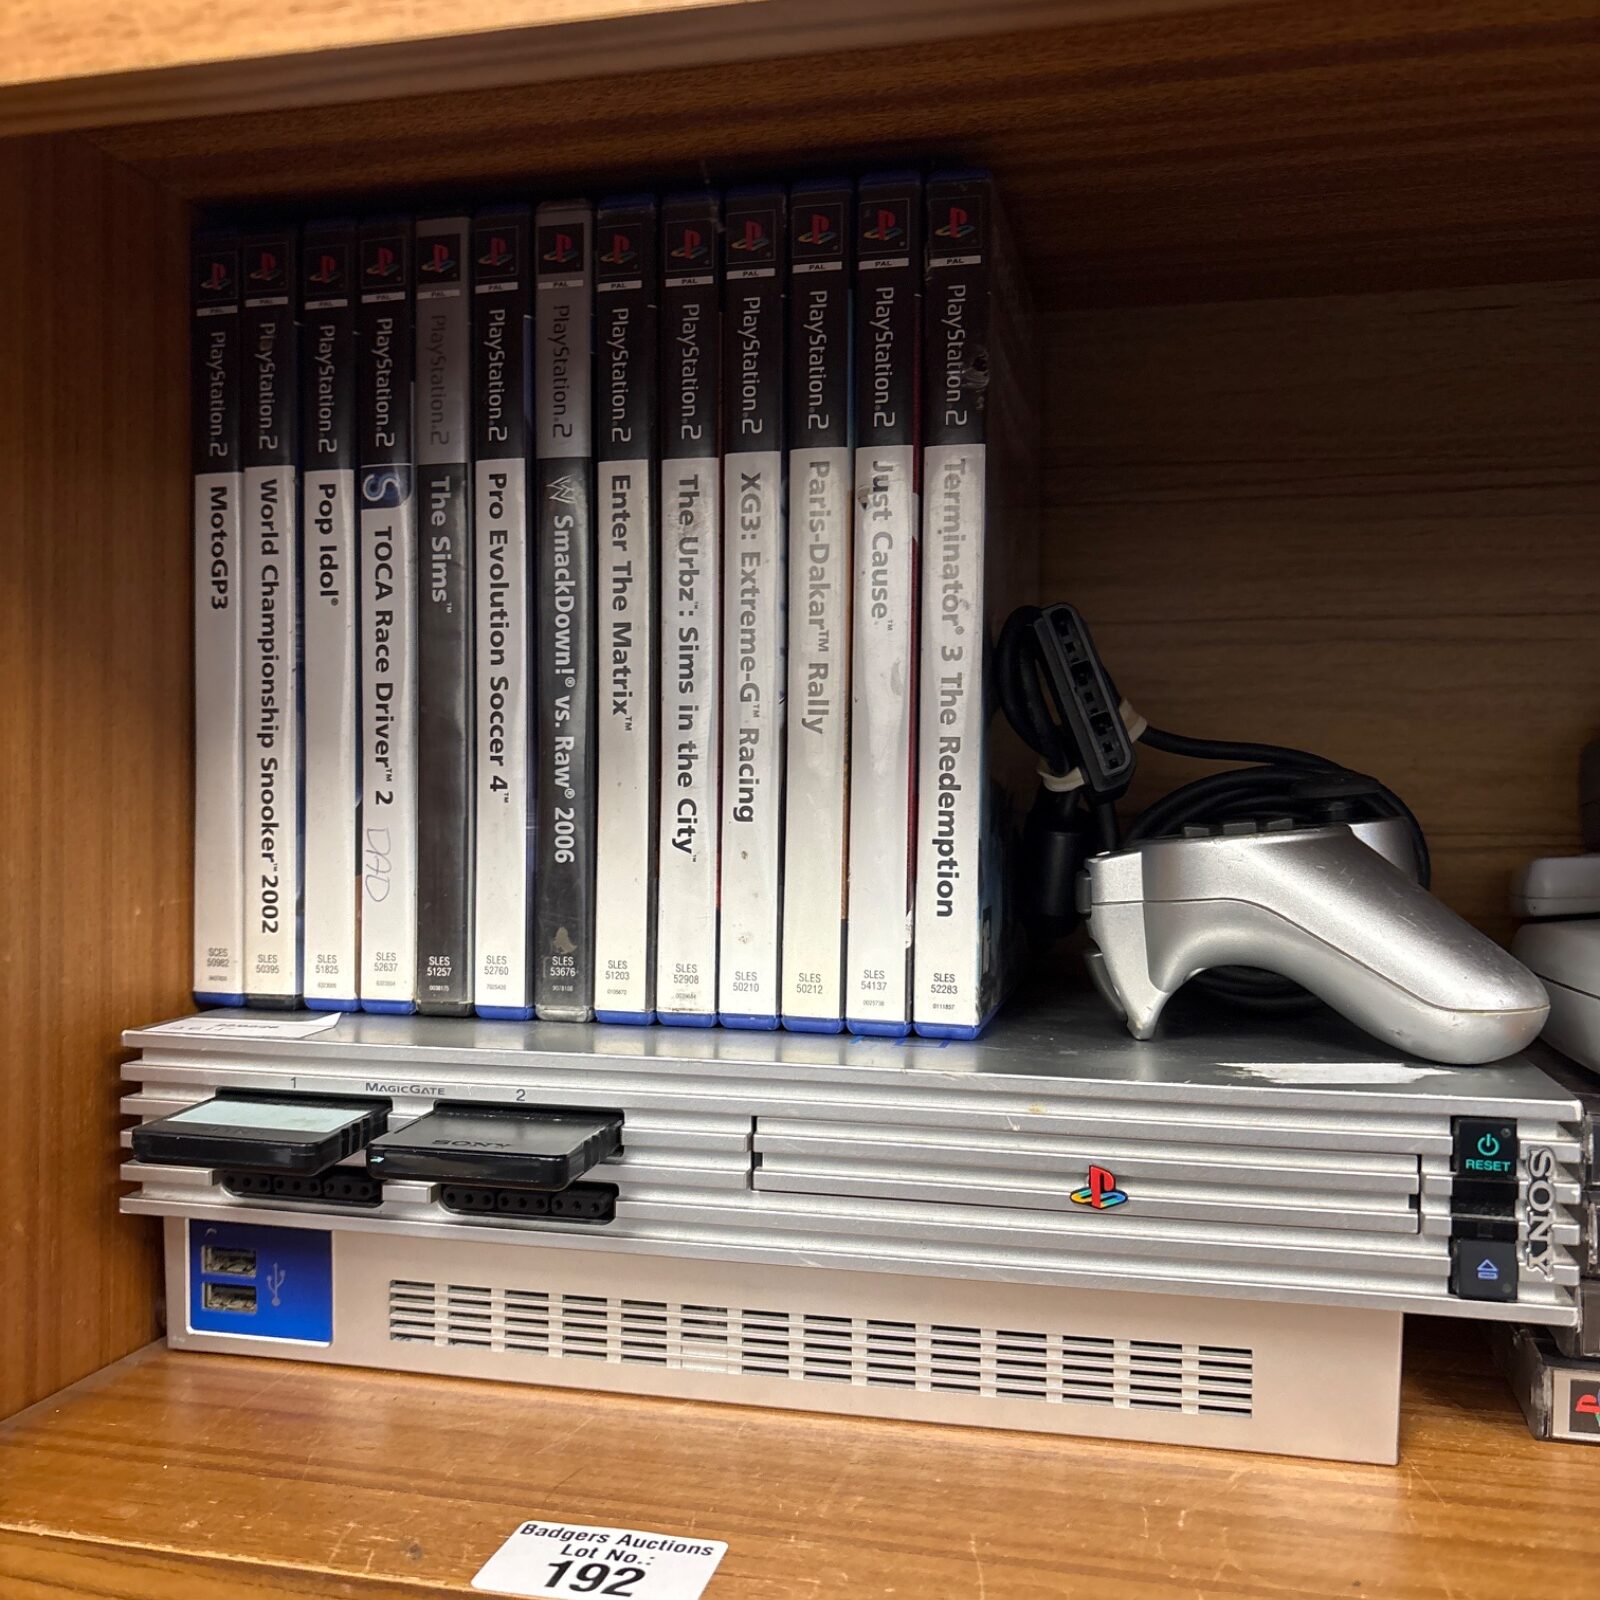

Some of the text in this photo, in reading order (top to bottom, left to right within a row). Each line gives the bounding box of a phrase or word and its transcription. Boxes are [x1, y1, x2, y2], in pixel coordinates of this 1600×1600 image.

[488, 473, 506, 520] Pro
[678, 474, 698, 526] The
[872, 461, 892, 520] Just
[315, 484, 336, 535] Pop
[431, 476, 450, 527] The
[740, 472, 761, 541] XG3:
[259, 479, 278, 555] World
[611, 475, 631, 551] Enter
[210, 486, 228, 609] MotoGP3
[374, 526, 393, 600] TOCA
[612, 561, 632, 611] The
[488, 530, 509, 666] Evolution
[375, 610, 393, 673] Race
[257, 563, 279, 749] Championship
[678, 628, 698, 694] Sims
[941, 646, 963, 662] 3
[801, 663, 828, 734] Rally
[940, 677, 963, 726] The
[554, 695, 571, 727] vs.
[678, 705, 697, 730] in
[489, 677, 509, 766] Soccer
[677, 740, 698, 788] the
[734, 728, 760, 823] Racing
[375, 791, 393, 805] 2
[554, 807, 575, 863] 2006
[932, 736, 960, 917] Redemption
[364, 827, 391, 902] DAD
[261, 875, 278, 934] 2002
[208, 948, 228, 957] SCES
[258, 954, 278, 964] SLES
[317, 954, 337, 964] SLES
[376, 952, 397, 962] SLES
[429, 956, 450, 966] SLES
[486, 955, 507, 965] SLES
[552, 956, 573, 967] SLES
[256, 964, 279, 974] 50395
[315, 964, 339, 974] 51825
[374, 962, 398, 972] 52637
[427, 966, 452, 977] 51257
[484, 965, 508, 976] 52760
[550, 966, 576, 977] 53676
[608, 960, 628, 970] SLES
[675, 963, 697, 974] SLES
[863, 970, 885, 980] SLES
[605, 970, 630, 981] 51203
[673, 974, 699, 985] 52908
[735, 971, 757, 982] SLES
[799, 973, 821, 983] SLES
[861, 980, 887, 991] 54137
[933, 973, 955, 983] SLES
[733, 981, 759, 993] 50210
[796, 983, 823, 994] 50212
[931, 983, 958, 994] 52283
[291, 1077, 297, 1089] 1
[515, 1089, 526, 1101] 2
[432, 1139, 512, 1149] SONY
[1465, 1159, 1511, 1172] RESET
[1526, 1146, 1556, 1281] SONY
[520, 1523, 714, 1556] Badgers Auctions
[560, 1544, 597, 1559] Lot
[543, 1560, 647, 1597] 192
